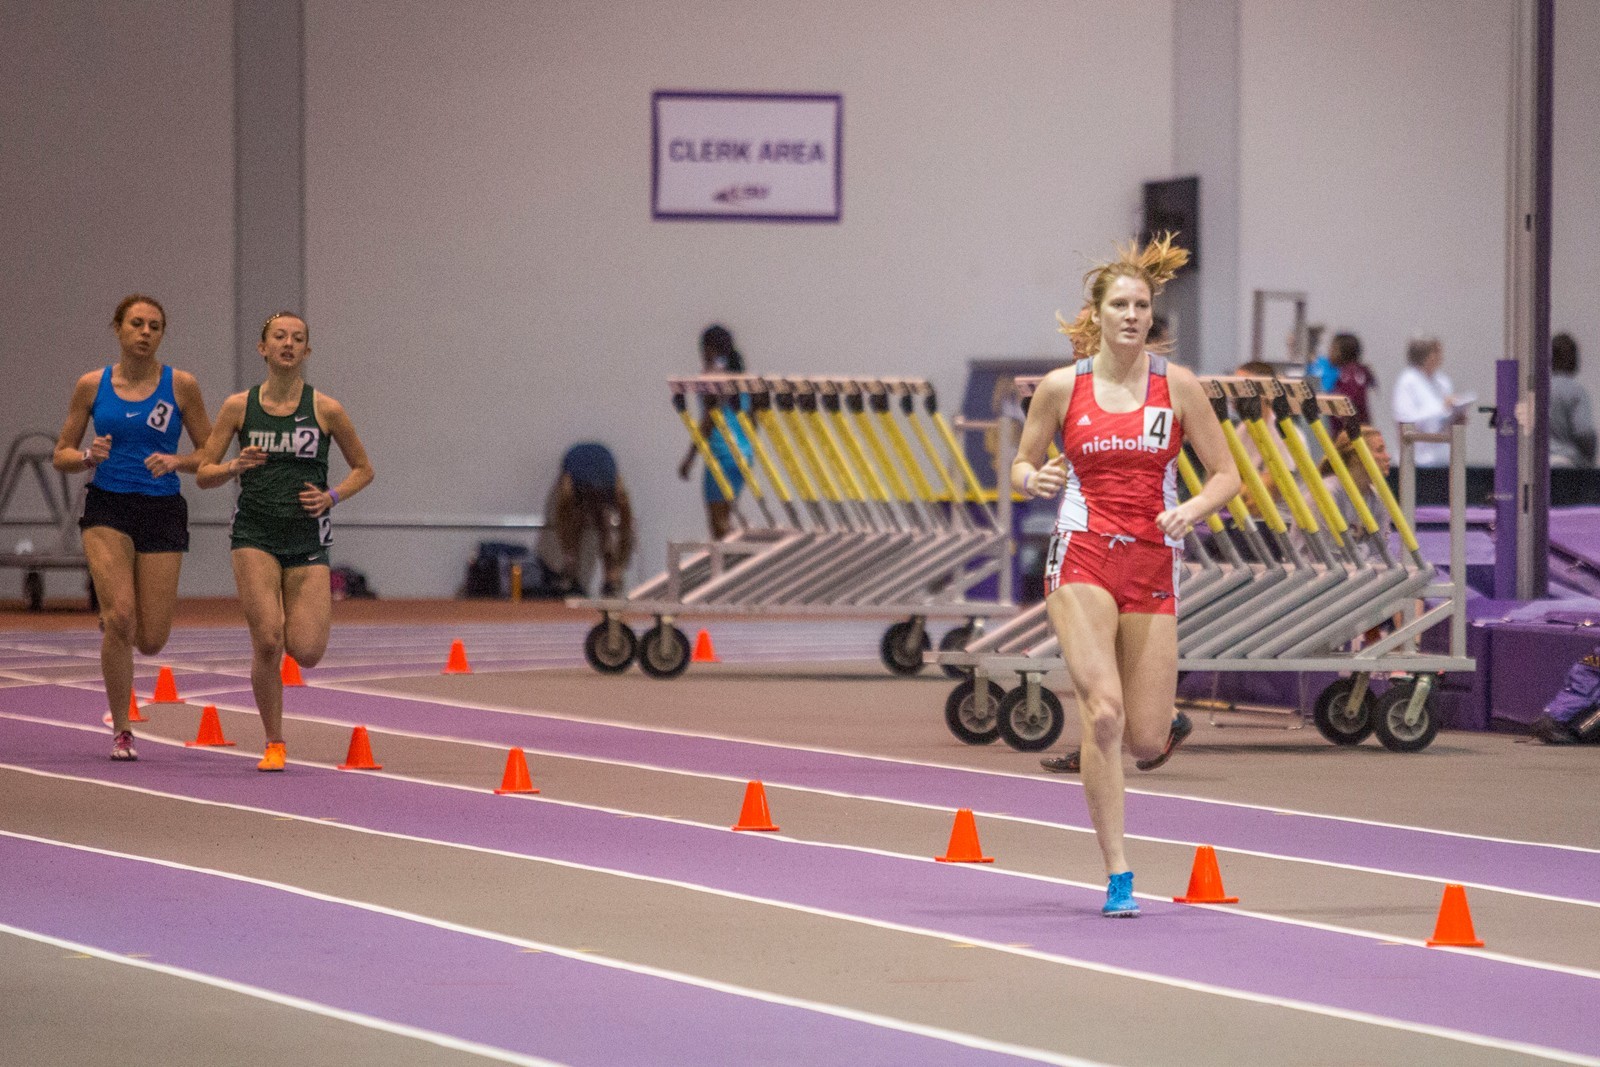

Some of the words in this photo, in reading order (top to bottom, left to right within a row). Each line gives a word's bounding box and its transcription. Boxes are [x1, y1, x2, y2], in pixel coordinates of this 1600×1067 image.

[669, 140, 749, 162] CLERK
[759, 141, 824, 164] AREA
[151, 402, 168, 428] 3
[1150, 411, 1166, 446] 4
[299, 430, 315, 455] 2
